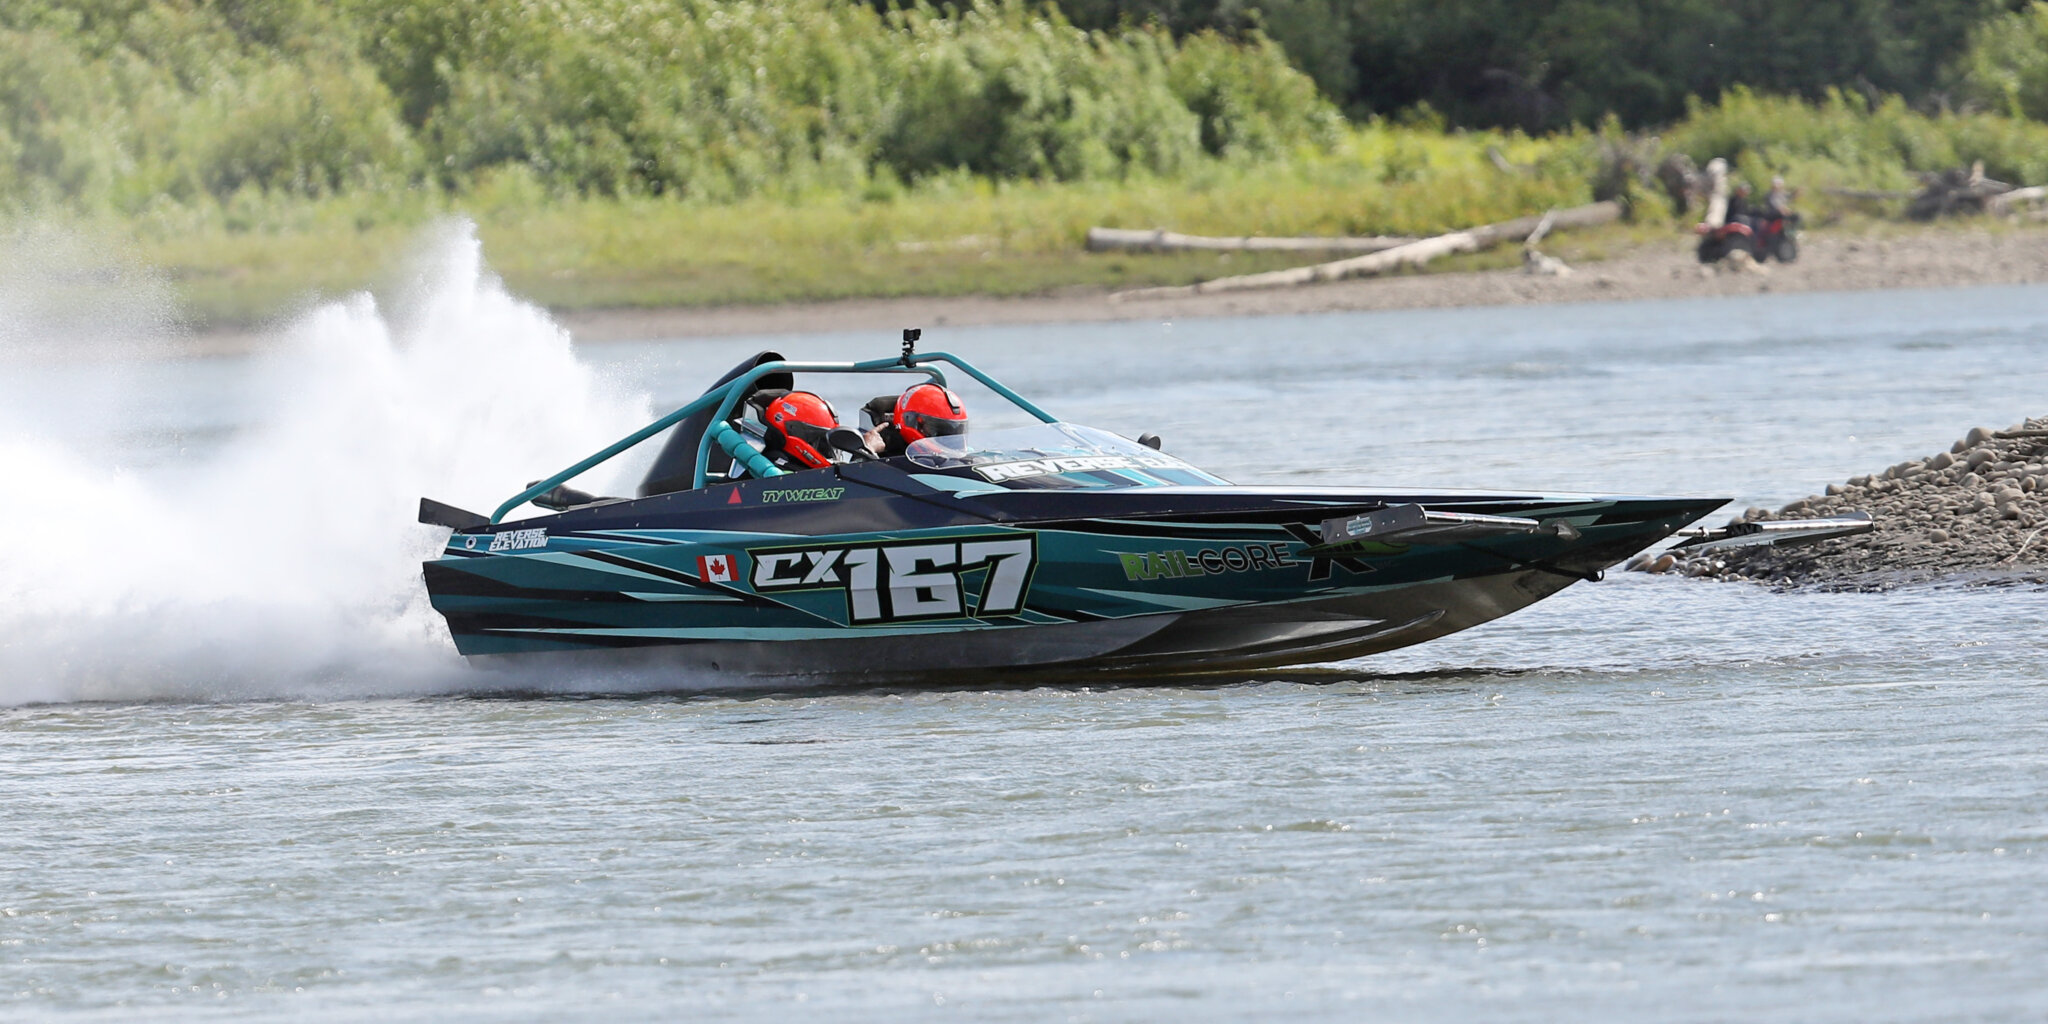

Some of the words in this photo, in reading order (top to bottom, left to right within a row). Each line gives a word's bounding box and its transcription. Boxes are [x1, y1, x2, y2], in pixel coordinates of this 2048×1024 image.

[976, 456, 1139, 480] REVERSE
[762, 490, 785, 502] TY
[785, 488, 844, 501] WHEAT
[494, 528, 547, 542] REVERSE
[489, 537, 549, 551] ELEVATION
[1118, 543, 1298, 581] RAILCORE
